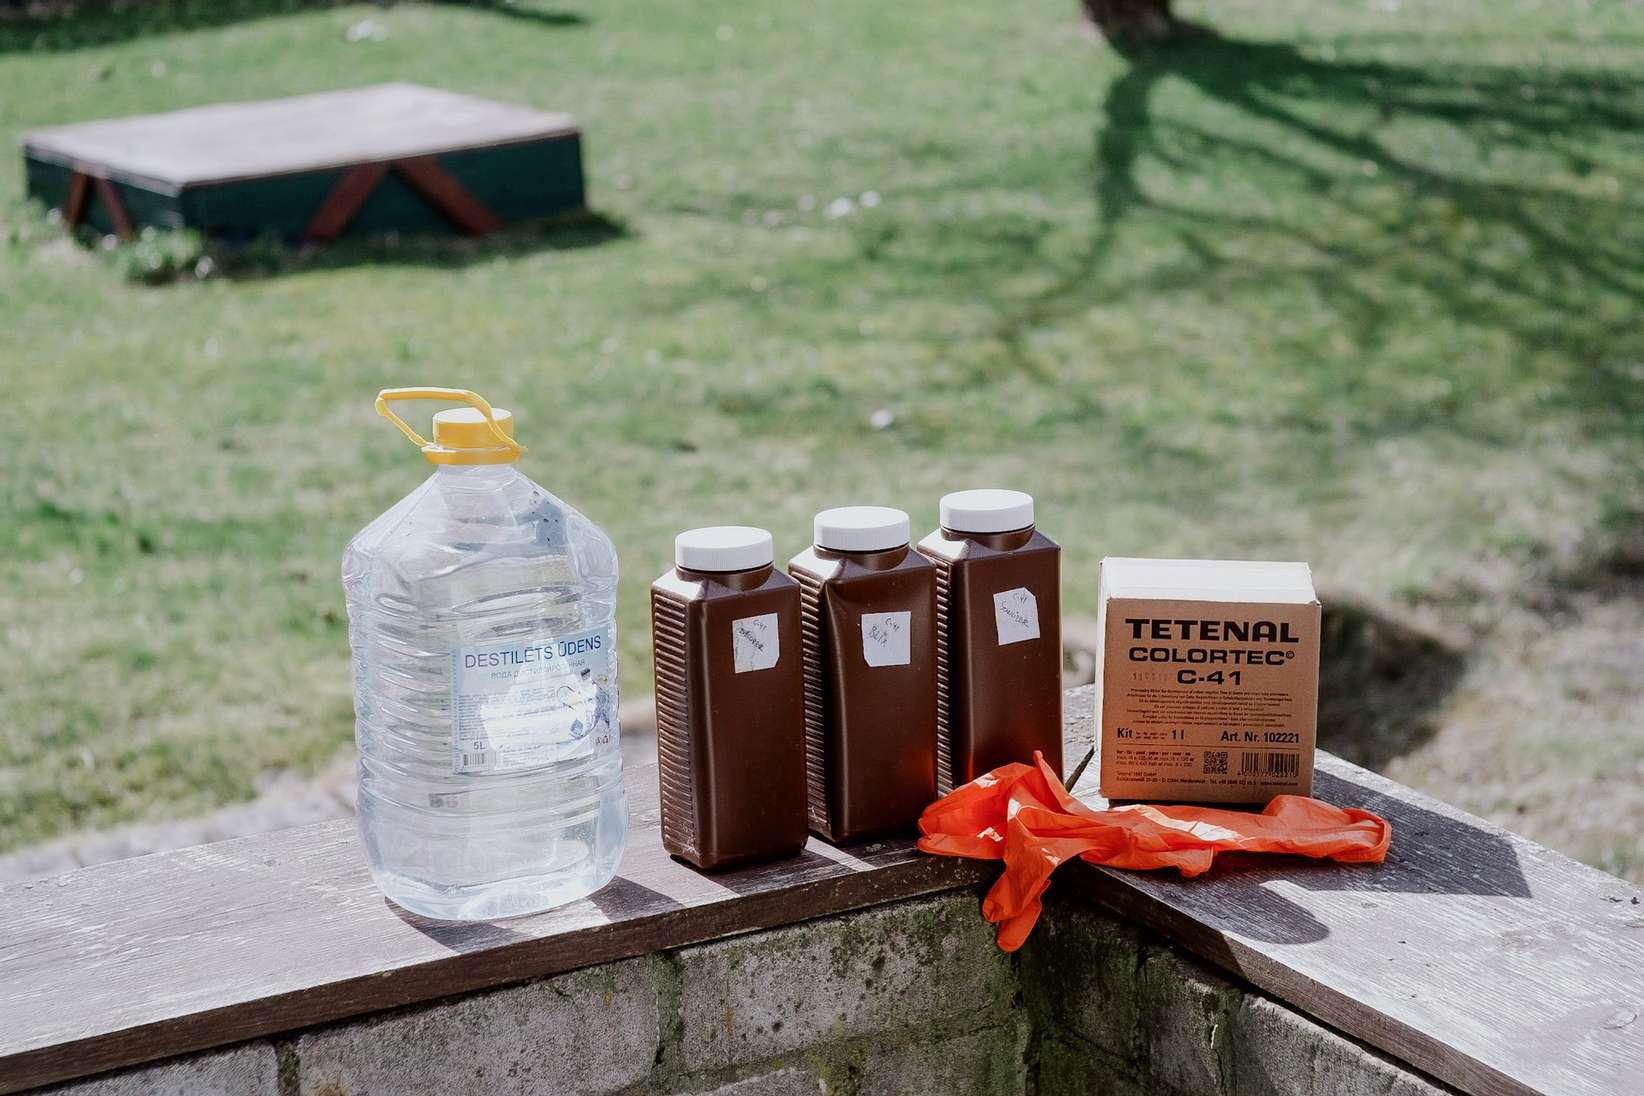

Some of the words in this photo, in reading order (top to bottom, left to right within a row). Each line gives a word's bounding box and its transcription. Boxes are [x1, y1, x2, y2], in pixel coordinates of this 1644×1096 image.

[1125, 618, 1299, 643] TETENAL
[1177, 669, 1241, 686] C-41
[1117, 727, 1132, 739] Kit
[1220, 730, 1241, 742] Art.
[1244, 731, 1260, 742] Nr.
[1263, 732, 1300, 744] 102221
